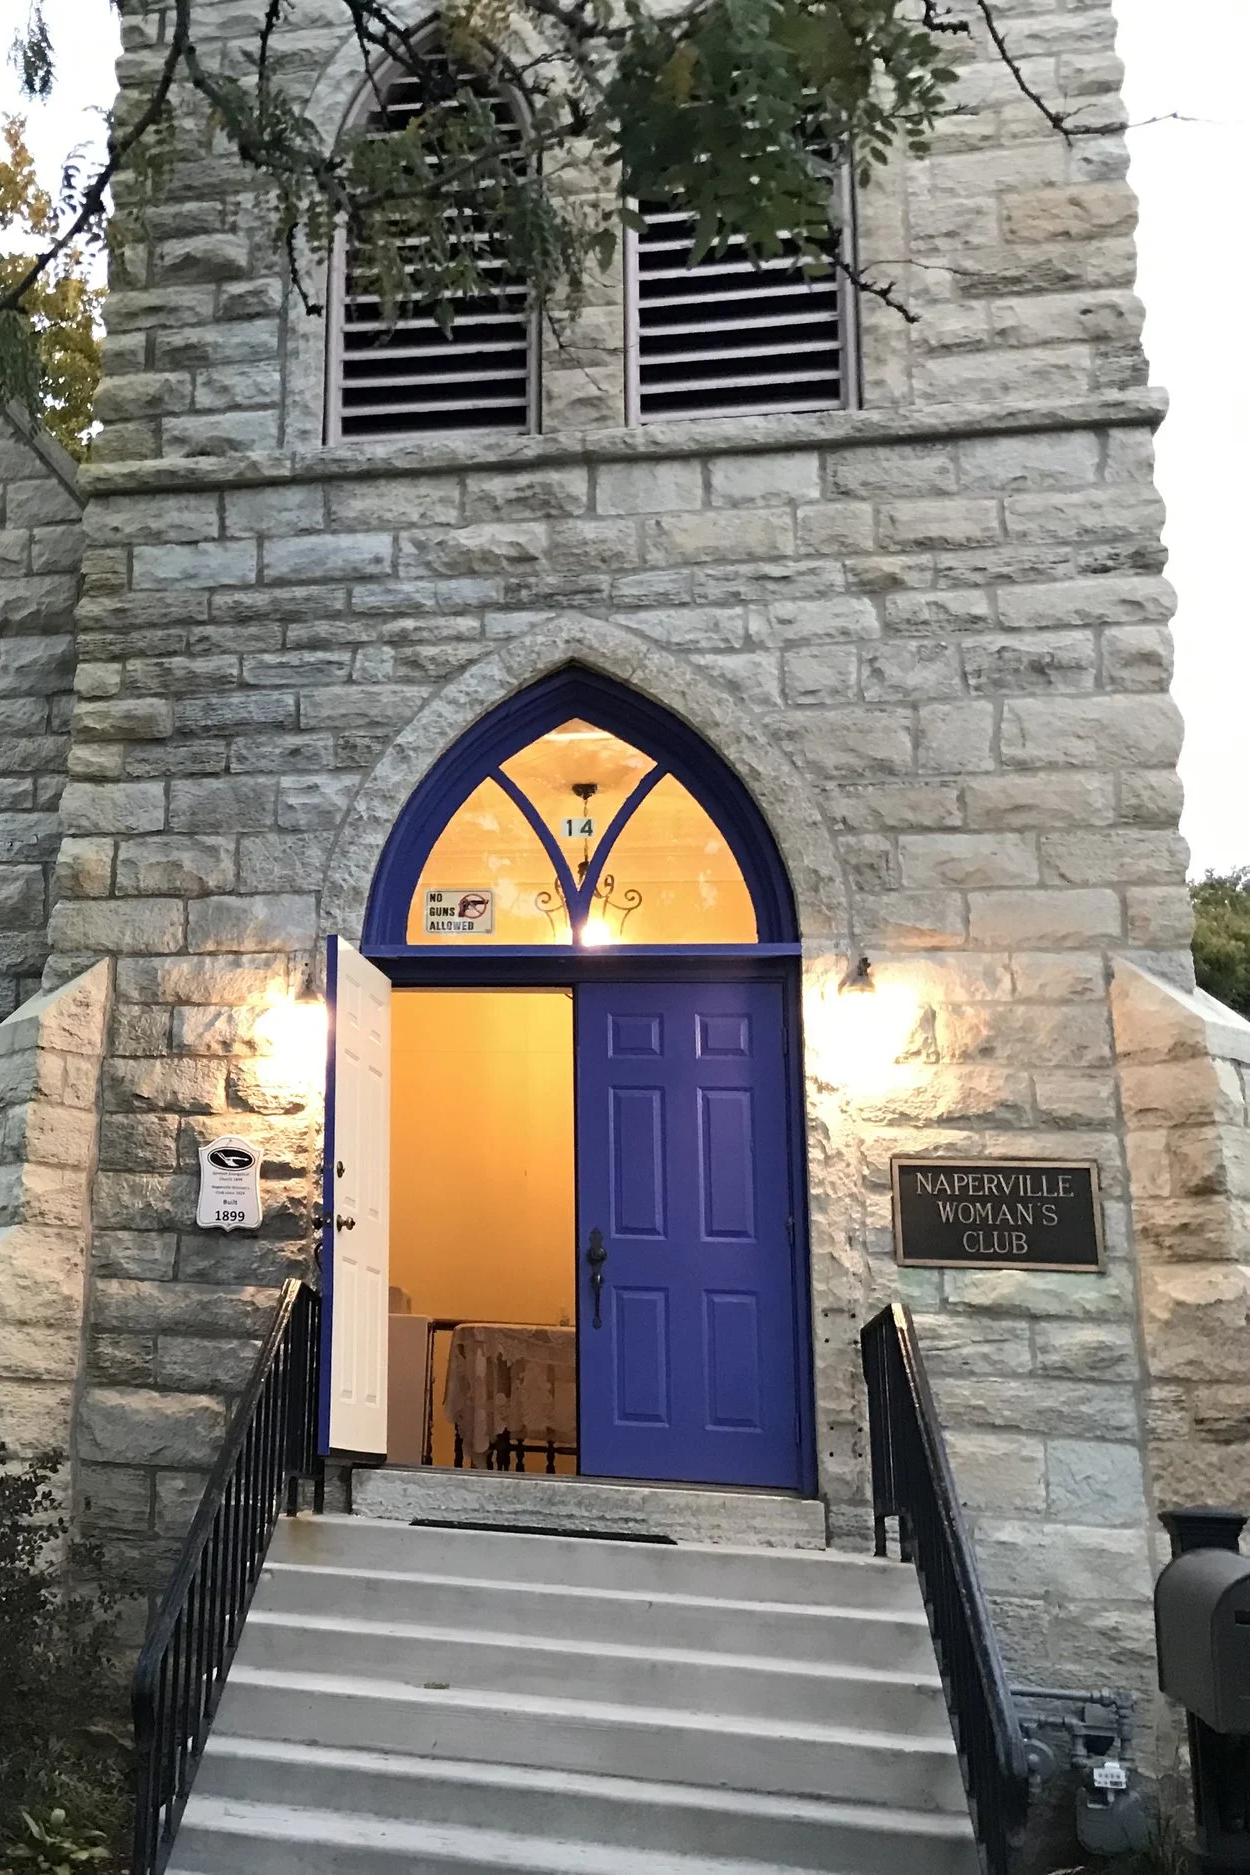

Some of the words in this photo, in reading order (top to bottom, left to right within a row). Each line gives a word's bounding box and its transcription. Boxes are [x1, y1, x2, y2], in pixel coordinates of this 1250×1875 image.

[566, 819, 593, 837] 14
[429, 893, 443, 902] NO
[429, 907, 456, 917] GUNS
[429, 921, 474, 931] ALLOWED
[915, 1172, 1075, 1198] NAPERVILLE
[214, 1210, 246, 1222] 1899
[937, 1200, 1059, 1226] WOMAN'S
[962, 1231, 1029, 1254] CLUB
